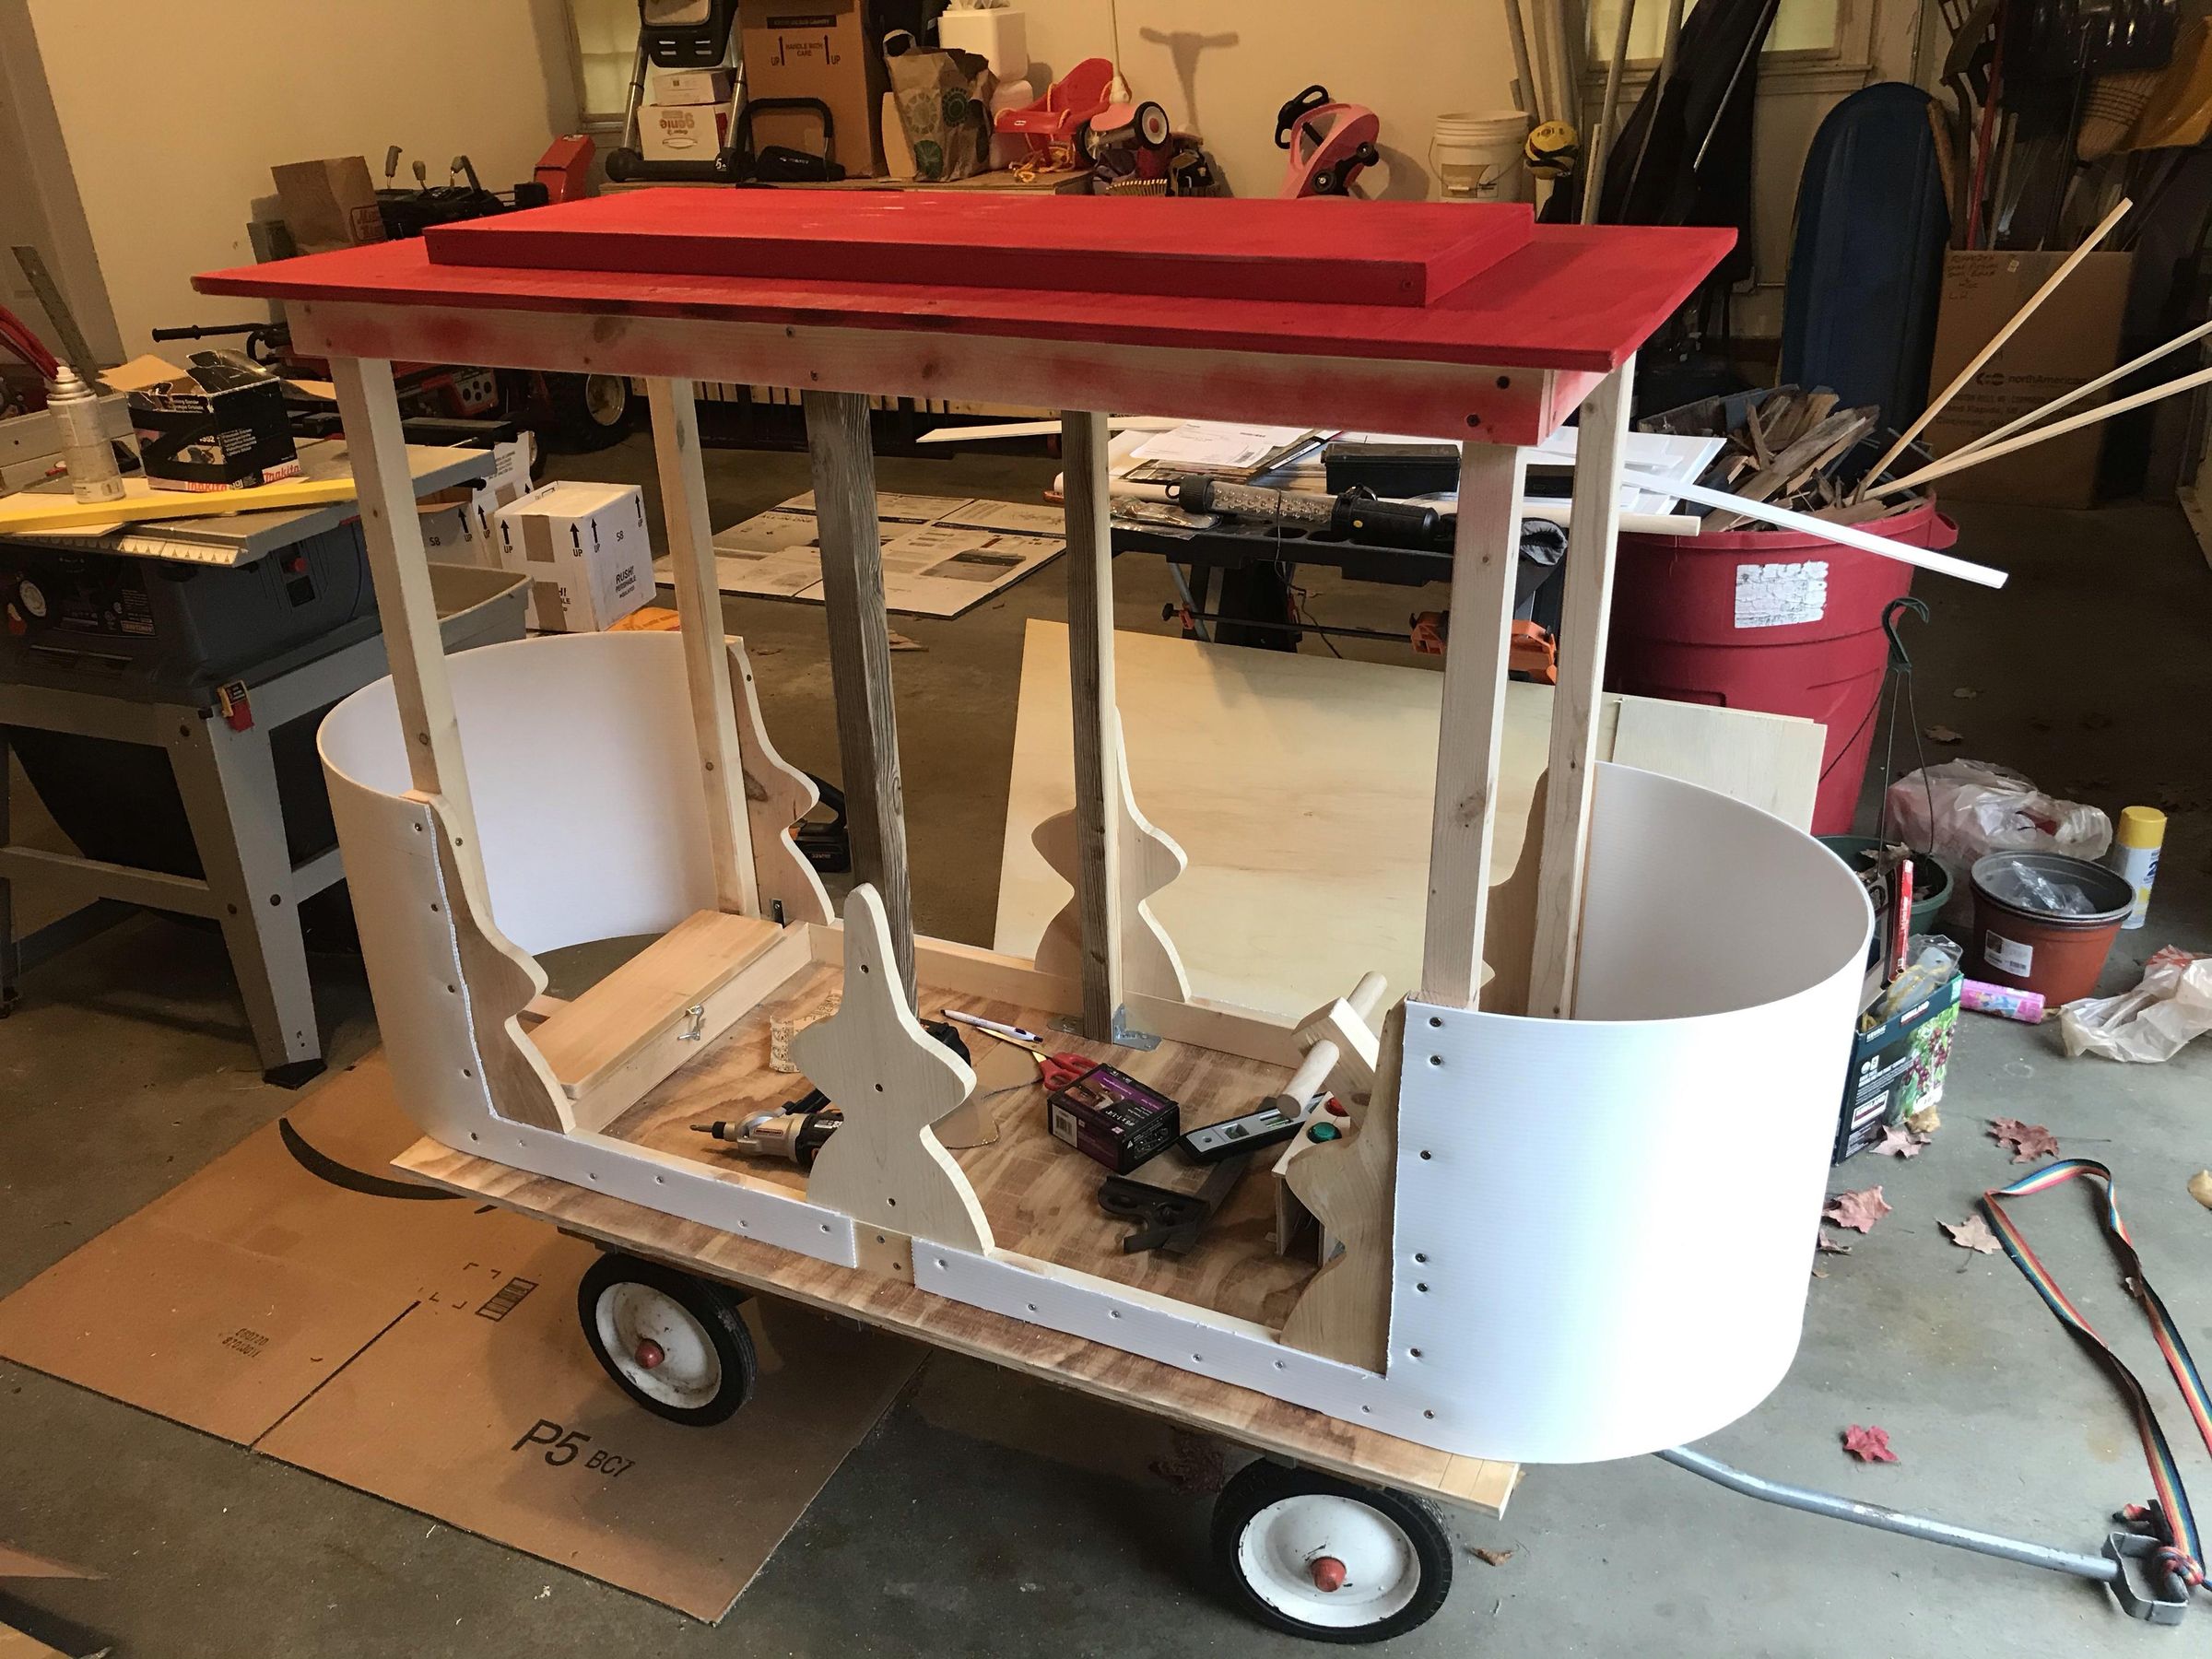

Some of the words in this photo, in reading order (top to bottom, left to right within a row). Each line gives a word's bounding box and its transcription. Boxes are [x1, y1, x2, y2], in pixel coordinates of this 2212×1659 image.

[771, 56, 780, 66] UP
[831, 55, 841, 65] UP
[464, 534, 473, 542] UP
[483, 530, 491, 539] UP
[504, 545, 513, 554] UP
[572, 548, 583, 558] UP
[594, 543, 601, 553] UP
[616, 566, 635, 583] RUSH!
[511, 1418, 593, 1466] P5
